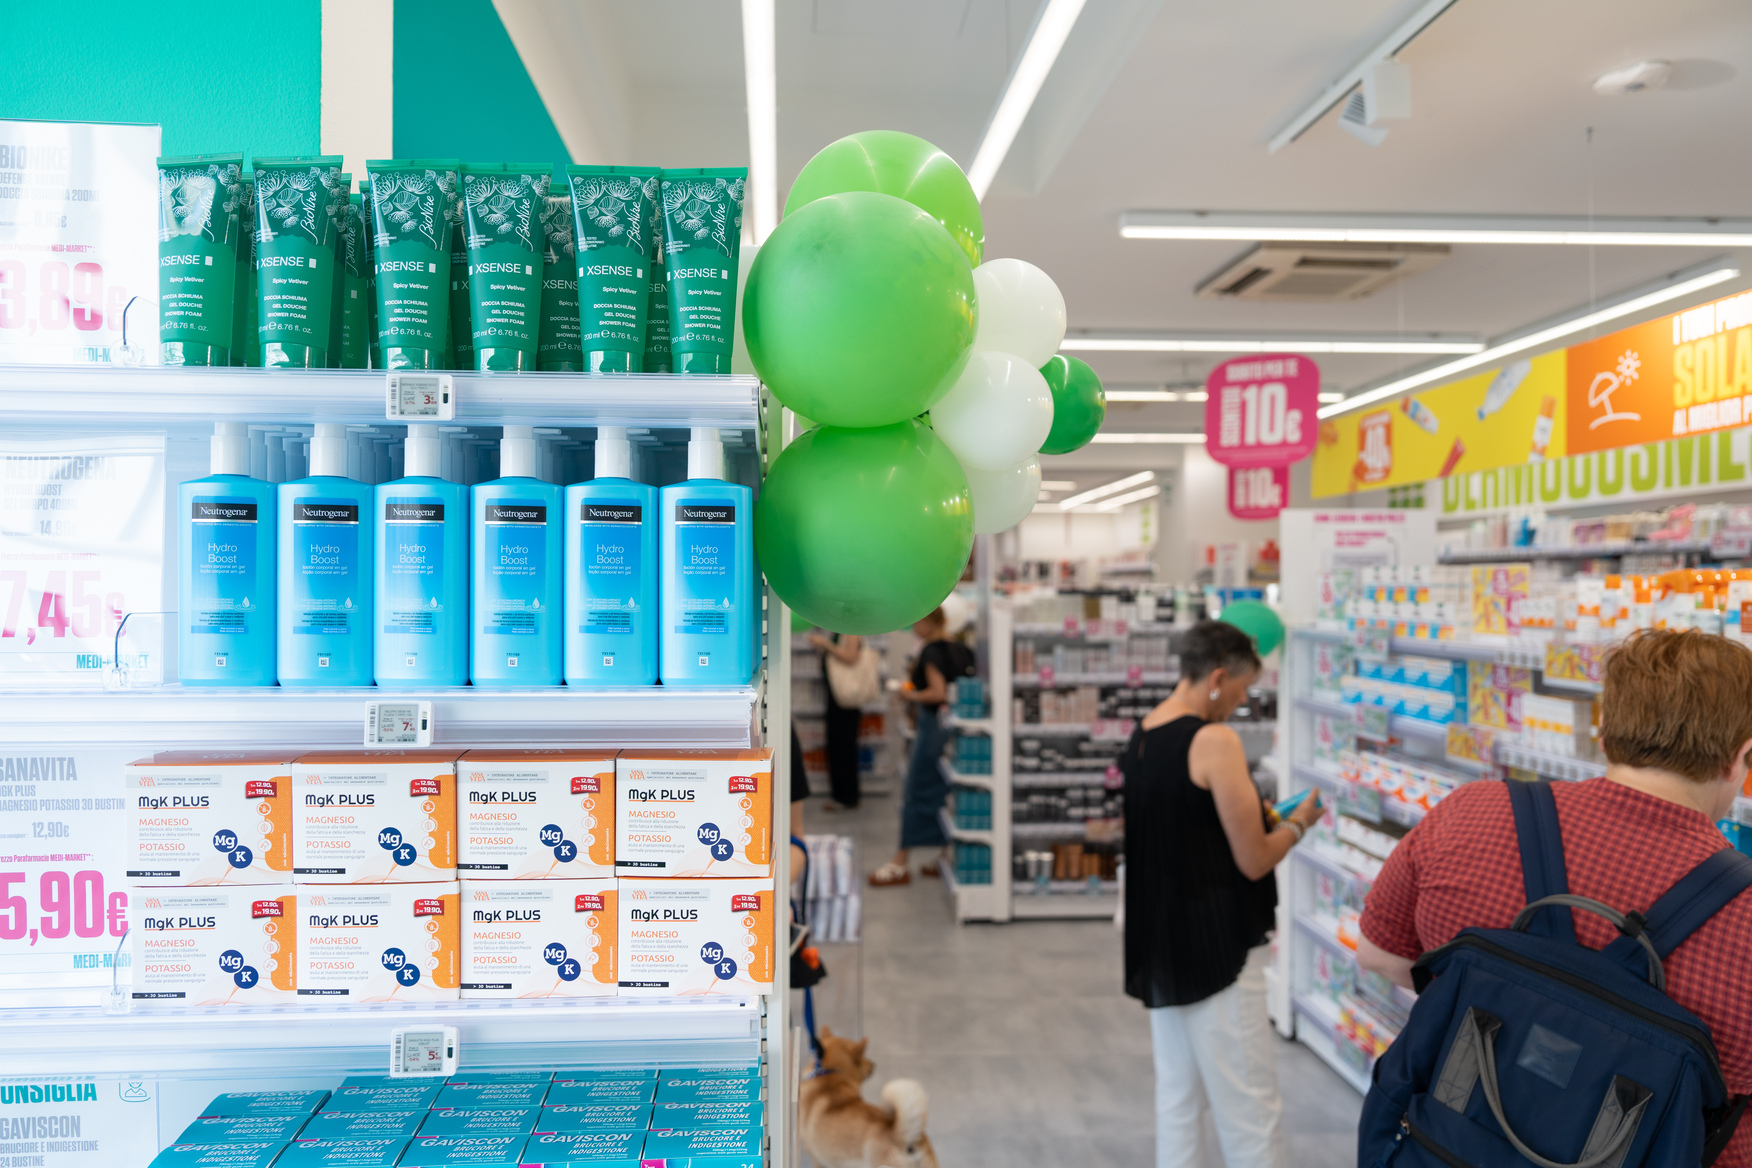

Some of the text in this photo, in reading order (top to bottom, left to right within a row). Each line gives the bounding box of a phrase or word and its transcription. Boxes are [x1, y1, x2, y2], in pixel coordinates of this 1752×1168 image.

[160, 255, 201, 267] XSENSE
[261, 257, 304, 268] XSENSE
[380, 261, 424, 272] XSENSE
[475, 263, 521, 274] XSENSE
[587, 265, 633, 277] XSENSE
[673, 268, 718, 280] XSENSE
[393, 282, 408, 290] Spicy
[602, 286, 637, 295] Spicy Vetiver
[35, 484, 63, 496] BOOST
[200, 506, 248, 518] Neutrogena
[302, 507, 350, 518] Neutrogena
[393, 507, 436, 518] Neutrogena
[493, 509, 538, 520] Neutrogena
[589, 508, 634, 519] Neutrogena
[683, 509, 727, 520] Neutrogena
[208, 543, 238, 553] Hydro
[310, 544, 340, 554] Hydro
[400, 543, 426, 554] Hydro
[500, 545, 529, 555] Hydro
[596, 544, 625, 555] Hydro
[691, 545, 719, 555] Hydro
[208, 554, 237, 563] Boost
[311, 555, 340, 564] Boost
[400, 554, 426, 564] Boost
[501, 556, 528, 565] Boost
[596, 555, 624, 564] Boost
[691, 556, 718, 565] Boost
[0, 785, 36, 797] GK PLUS
[629, 789, 695, 802] MgK PLUS
[138, 796, 210, 810] MgK PLUS
[305, 794, 375, 808] MgK PLUS
[469, 791, 537, 804] MgK PLUS
[0, 798, 126, 811] AGNESIO POTASSIO 30 BUSTIN
[139, 818, 189, 826] MAGNESIO
[306, 816, 355, 824] MAGNESIO
[32, 821, 70, 840] 12,90€
[699, 829, 718, 841] Mg
[541, 830, 561, 843] Mg
[139, 843, 185, 851] POTASSIO
[306, 841, 351, 849] POTASSIO
[718, 844, 728, 855] K
[561, 846, 571, 856] K
[14, 855, 49, 863] Parafarmacie
[0, 870, 129, 947] 5,90€
[473, 910, 541, 923] MgK PLUS
[631, 909, 698, 922] MgK PLUS
[145, 917, 216, 931] MgK PLUS
[310, 915, 379, 928] MgK PLUS
[474, 956, 518, 964] POTASSIO
[665, 1102, 751, 1110] GAVISCON
[0, 1115, 81, 1140] GAVISCON
[539, 1133, 634, 1143] GAVISCON
[657, 1129, 749, 1138] GAVISCON
[0, 1140, 99, 1154] BRUCIORE E INDIGESTIONE
[299, 1139, 397, 1148] GAVISCON
[421, 1137, 516, 1146] GAVISCON
[1, 1156, 44, 1168] 24 BUSTINE
